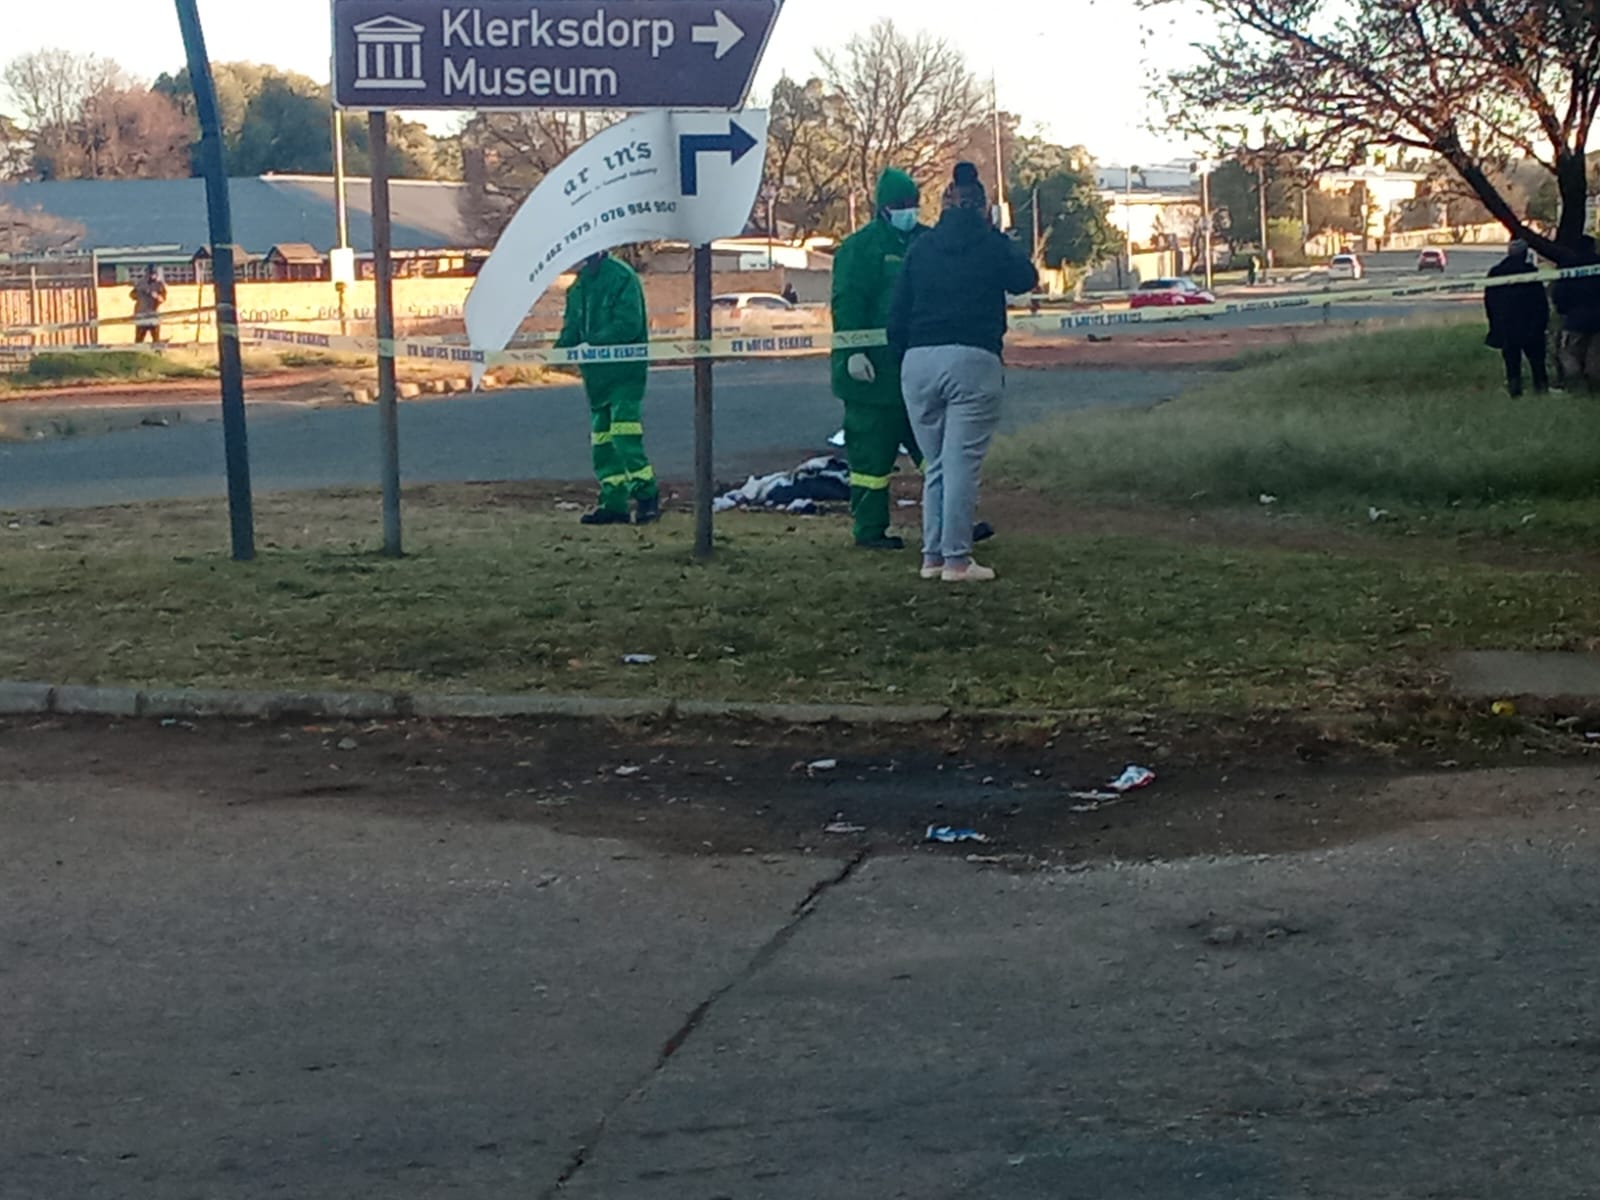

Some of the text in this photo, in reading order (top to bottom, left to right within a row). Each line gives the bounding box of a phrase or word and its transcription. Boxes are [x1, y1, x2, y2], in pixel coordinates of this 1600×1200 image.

[442, 9, 675, 57] Klerksdorp
[442, 58, 618, 96] Museum
[564, 221, 592, 245] 7675
[600, 207, 627, 224] 076
